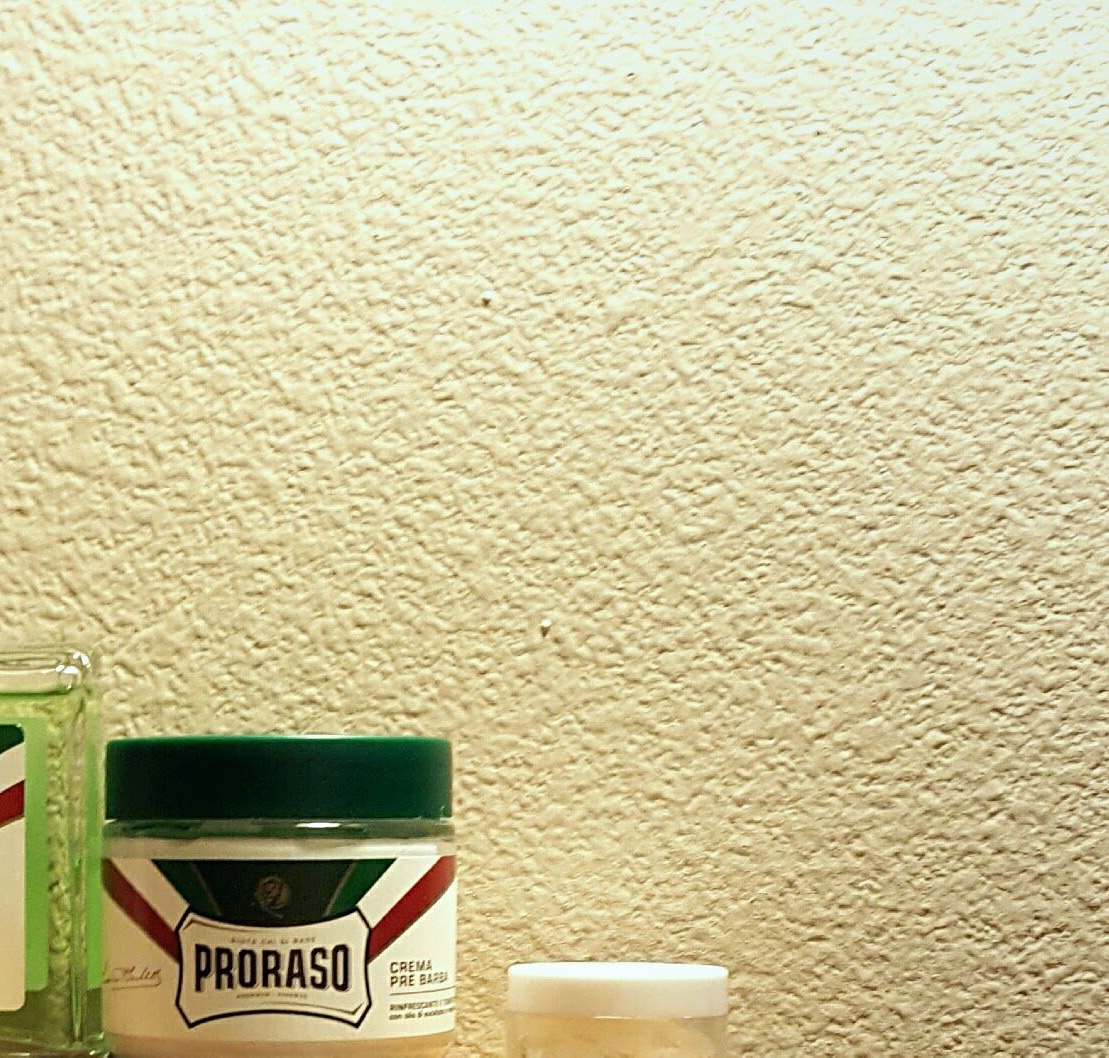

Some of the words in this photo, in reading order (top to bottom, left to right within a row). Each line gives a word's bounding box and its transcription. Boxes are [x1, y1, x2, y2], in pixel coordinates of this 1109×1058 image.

[194, 943, 351, 993] PRORASO
[389, 959, 433, 974] CREMA
[389, 974, 416, 988] PRE
